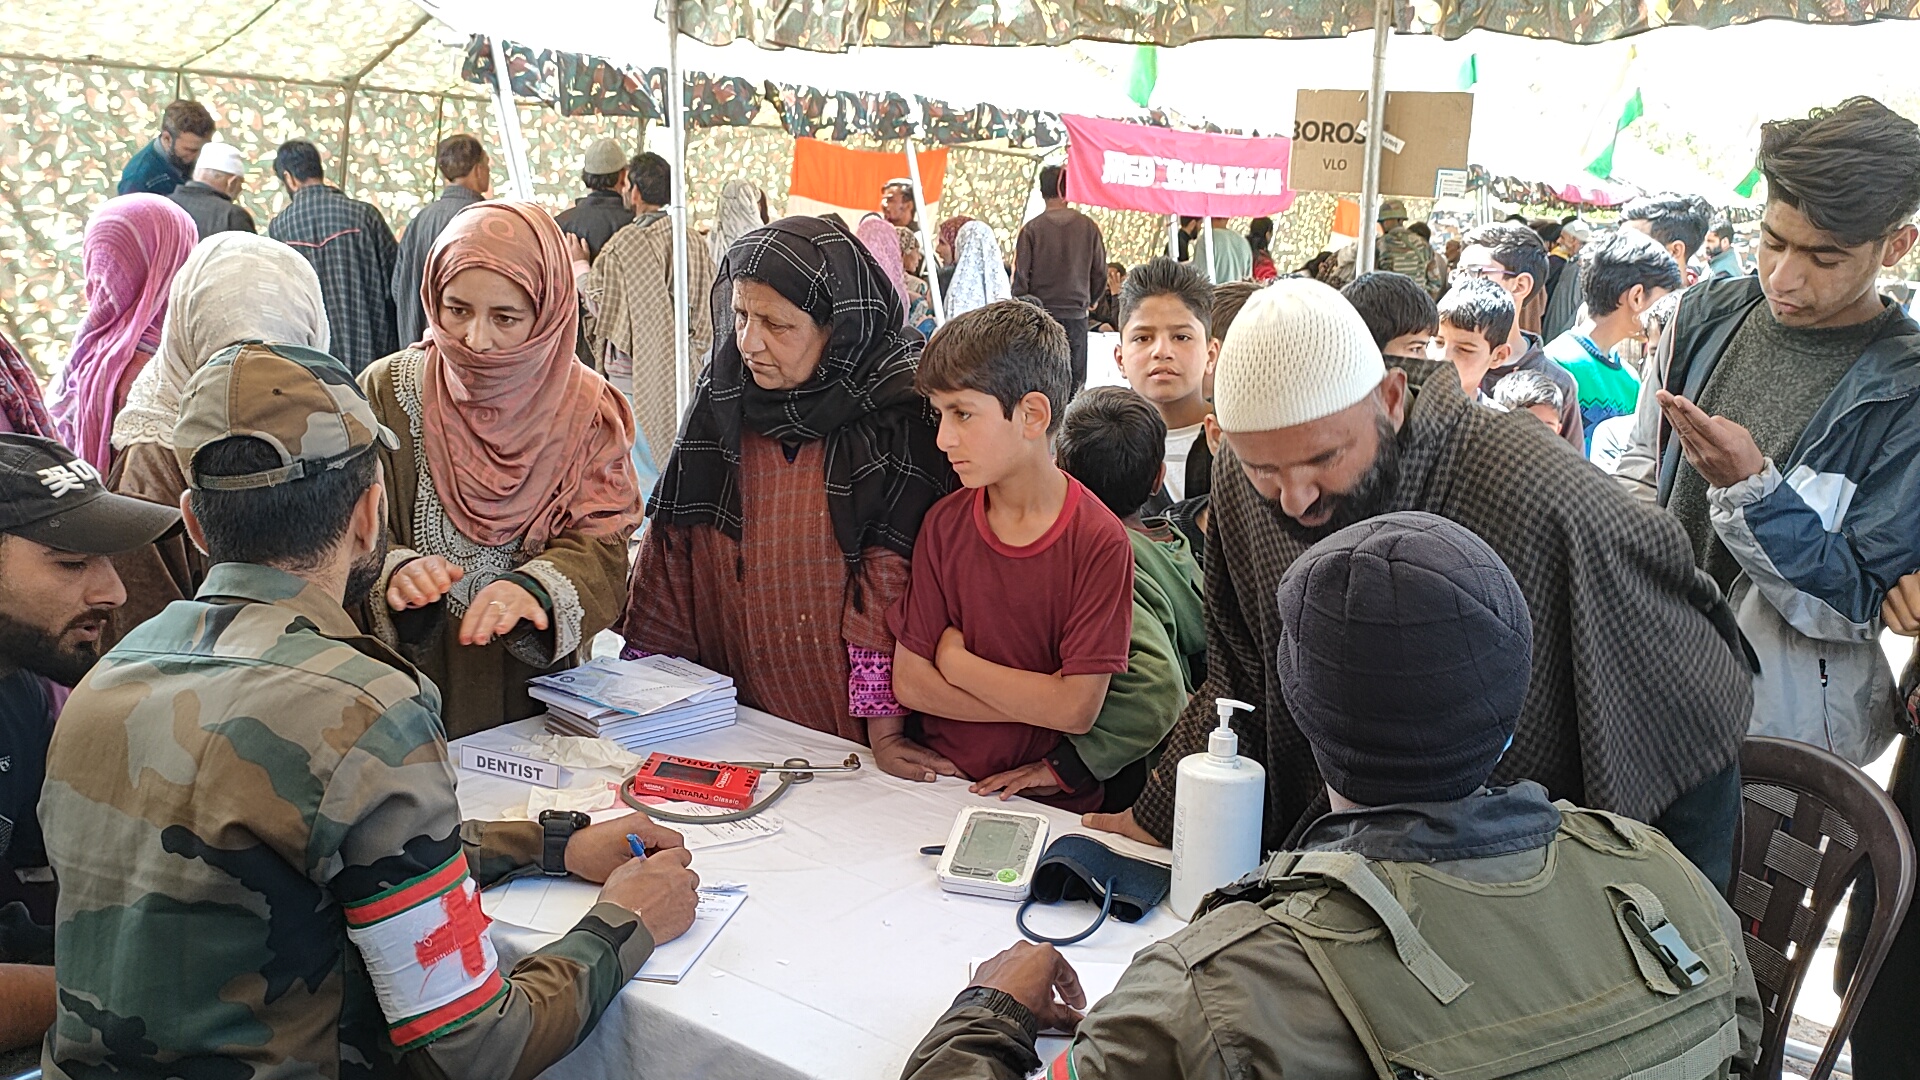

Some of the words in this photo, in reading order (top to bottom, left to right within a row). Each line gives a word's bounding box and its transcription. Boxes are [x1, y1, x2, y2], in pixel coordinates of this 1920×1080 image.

[1322, 158, 1348, 171] VLO
[476, 755, 544, 781] DENTIST
[672, 788, 710, 800] NATARAJ
[713, 795, 740, 805] Classic
